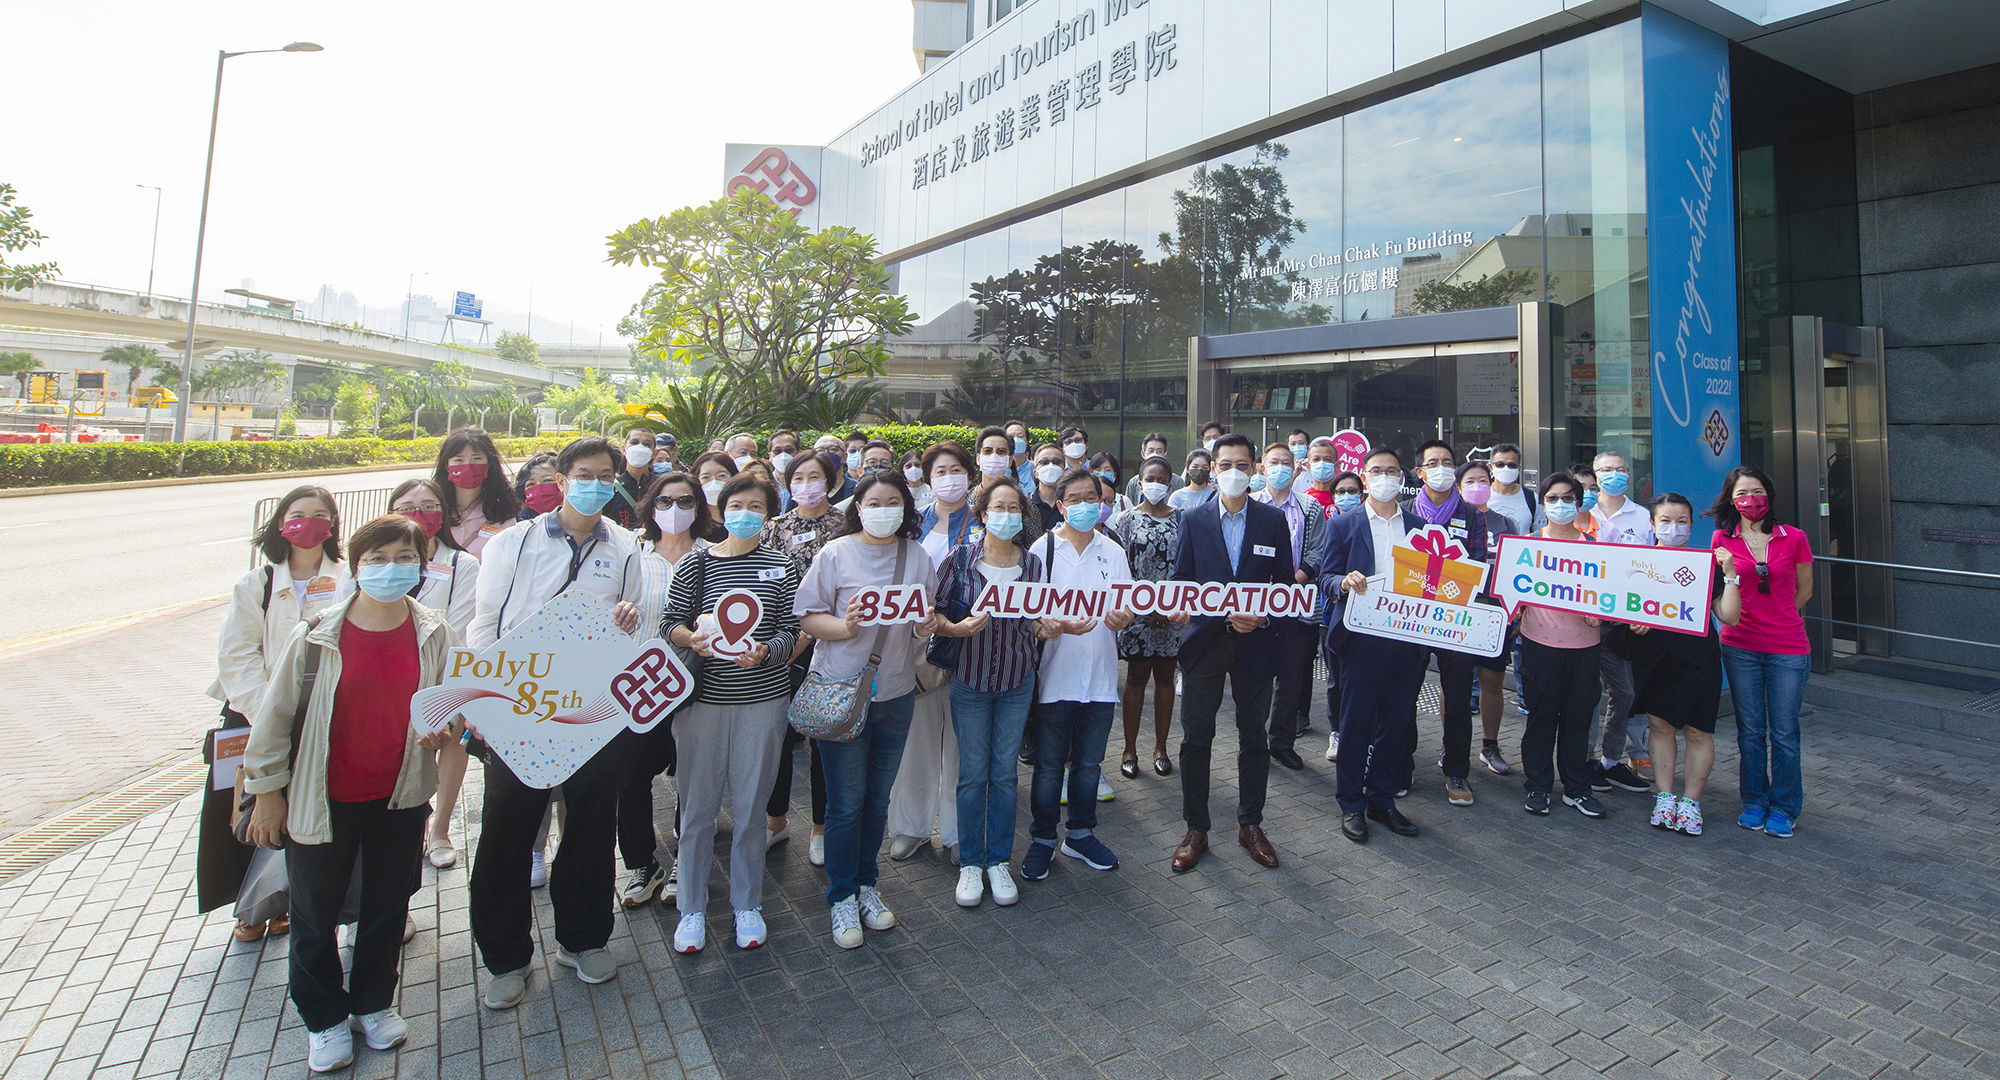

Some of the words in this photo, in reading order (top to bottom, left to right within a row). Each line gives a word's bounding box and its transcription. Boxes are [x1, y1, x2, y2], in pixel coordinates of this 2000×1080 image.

[860, 119, 902, 168] School
[905, 107, 921, 142] of
[922, 80, 964, 133] Hotel
[967, 54, 1006, 105] and
[1010, 8, 1095, 81] Tourism
[912, 23, 1178, 190] 酒店及旅遊業管理學院
[1241, 266, 1259, 281] Mr
[1260, 261, 1280, 277] and
[1283, 258, 1307, 274] Mrs
[1309, 252, 1342, 269] Chan
[1345, 242, 1381, 263] Chak
[1385, 240, 1404, 256] Fu
[1406, 229, 1473, 253] Building
[1654, 65, 1731, 427] Congratulations
[1291, 265, 1400, 302] 陳澤富伉儷樓
[1692, 352, 1719, 370] Class
[1720, 356, 1732, 371] of
[1706, 377, 1732, 395] 2022!
[1339, 452, 1360, 466] Are
[1408, 569, 1431, 581] PolyU
[1515, 547, 1607, 580] Alumni
[1631, 559, 1657, 571] PolyU
[1647, 570, 1667, 582] 85th
[858, 588, 926, 622] 85A
[976, 584, 1107, 618] ALUMNI
[1111, 583, 1314, 614] TOURCATION
[1420, 580, 1437, 592] 85th
[1513, 573, 1617, 614] Coming
[1626, 591, 1695, 623] Back
[1374, 595, 1431, 620] PolyU
[1432, 606, 1473, 627] 85th
[1382, 615, 1468, 644] Anniversary
[449, 650, 556, 687] PolyU
[512, 681, 583, 724] 85th
